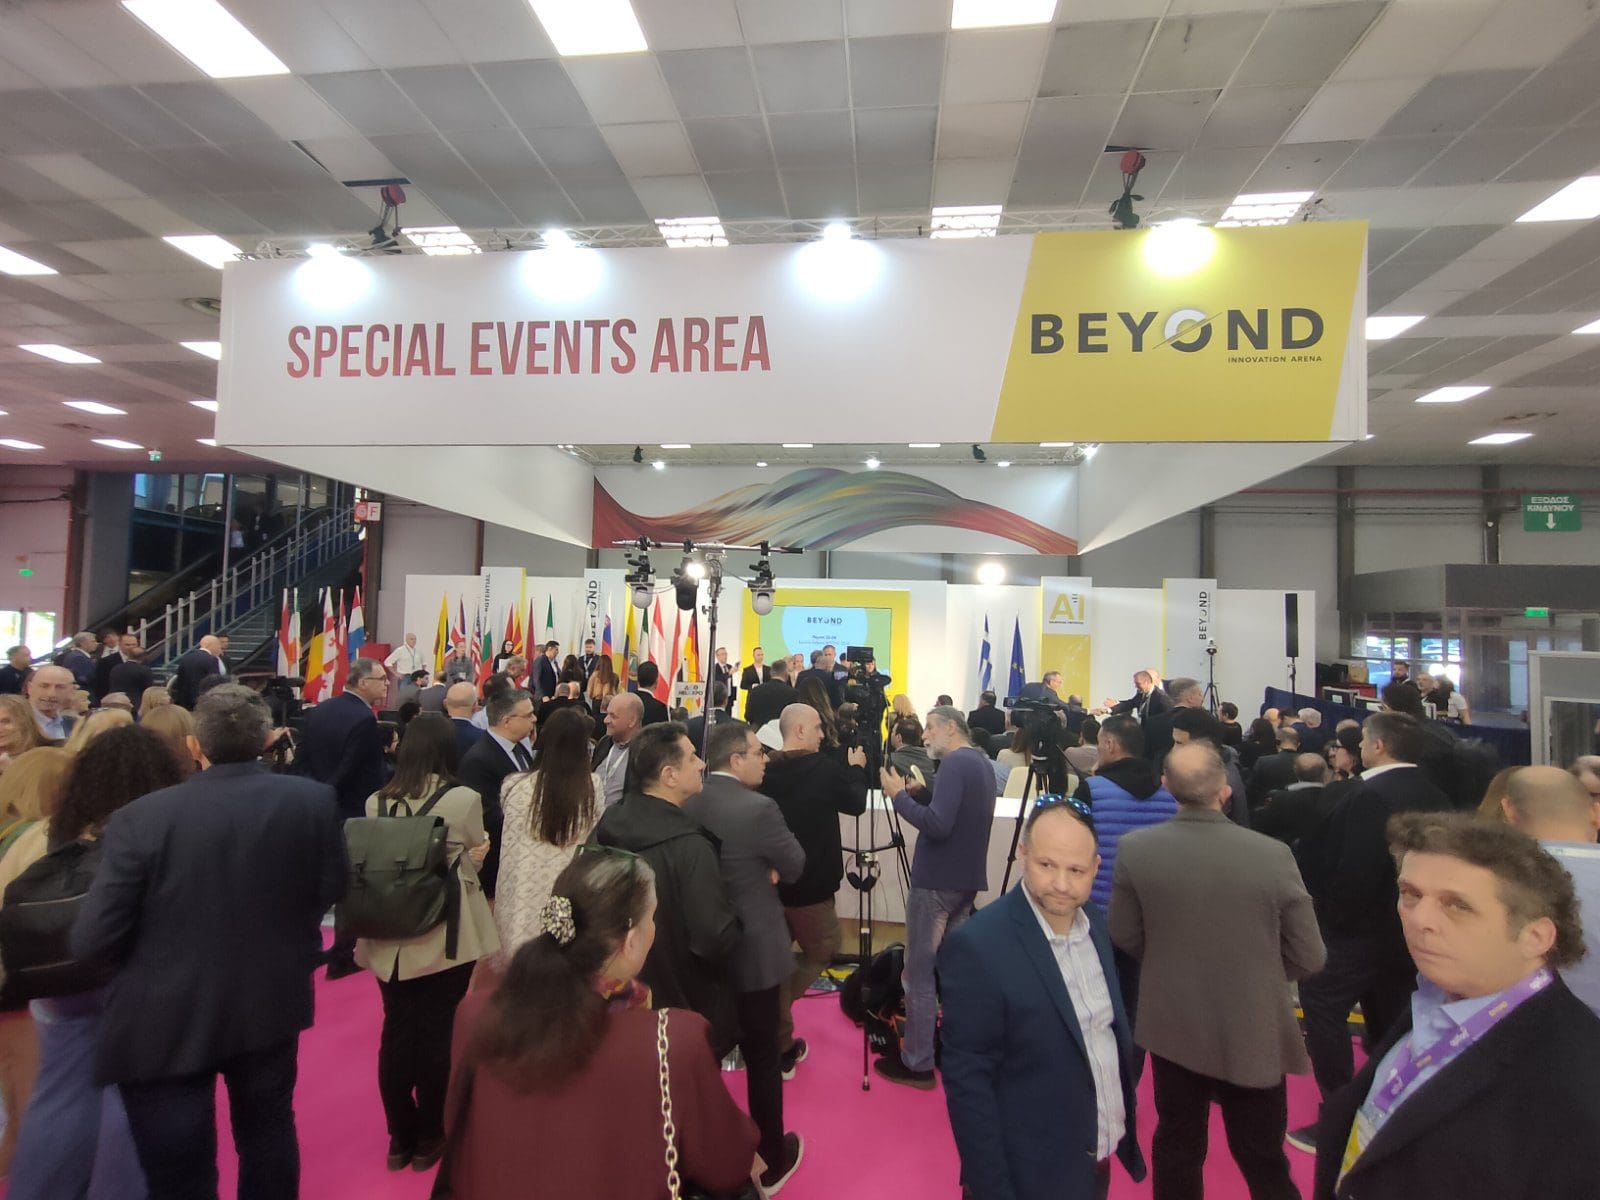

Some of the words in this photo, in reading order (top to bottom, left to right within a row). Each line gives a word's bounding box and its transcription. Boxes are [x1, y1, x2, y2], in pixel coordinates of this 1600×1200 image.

[286, 322, 456, 378] SPECIAL
[470, 318, 637, 375] EVENTS
[650, 315, 771, 373] AREA
[1031, 308, 1324, 354] BEYOND
[807, 616, 843, 624] BEYOND
[1199, 591, 1207, 640] BEYOND
